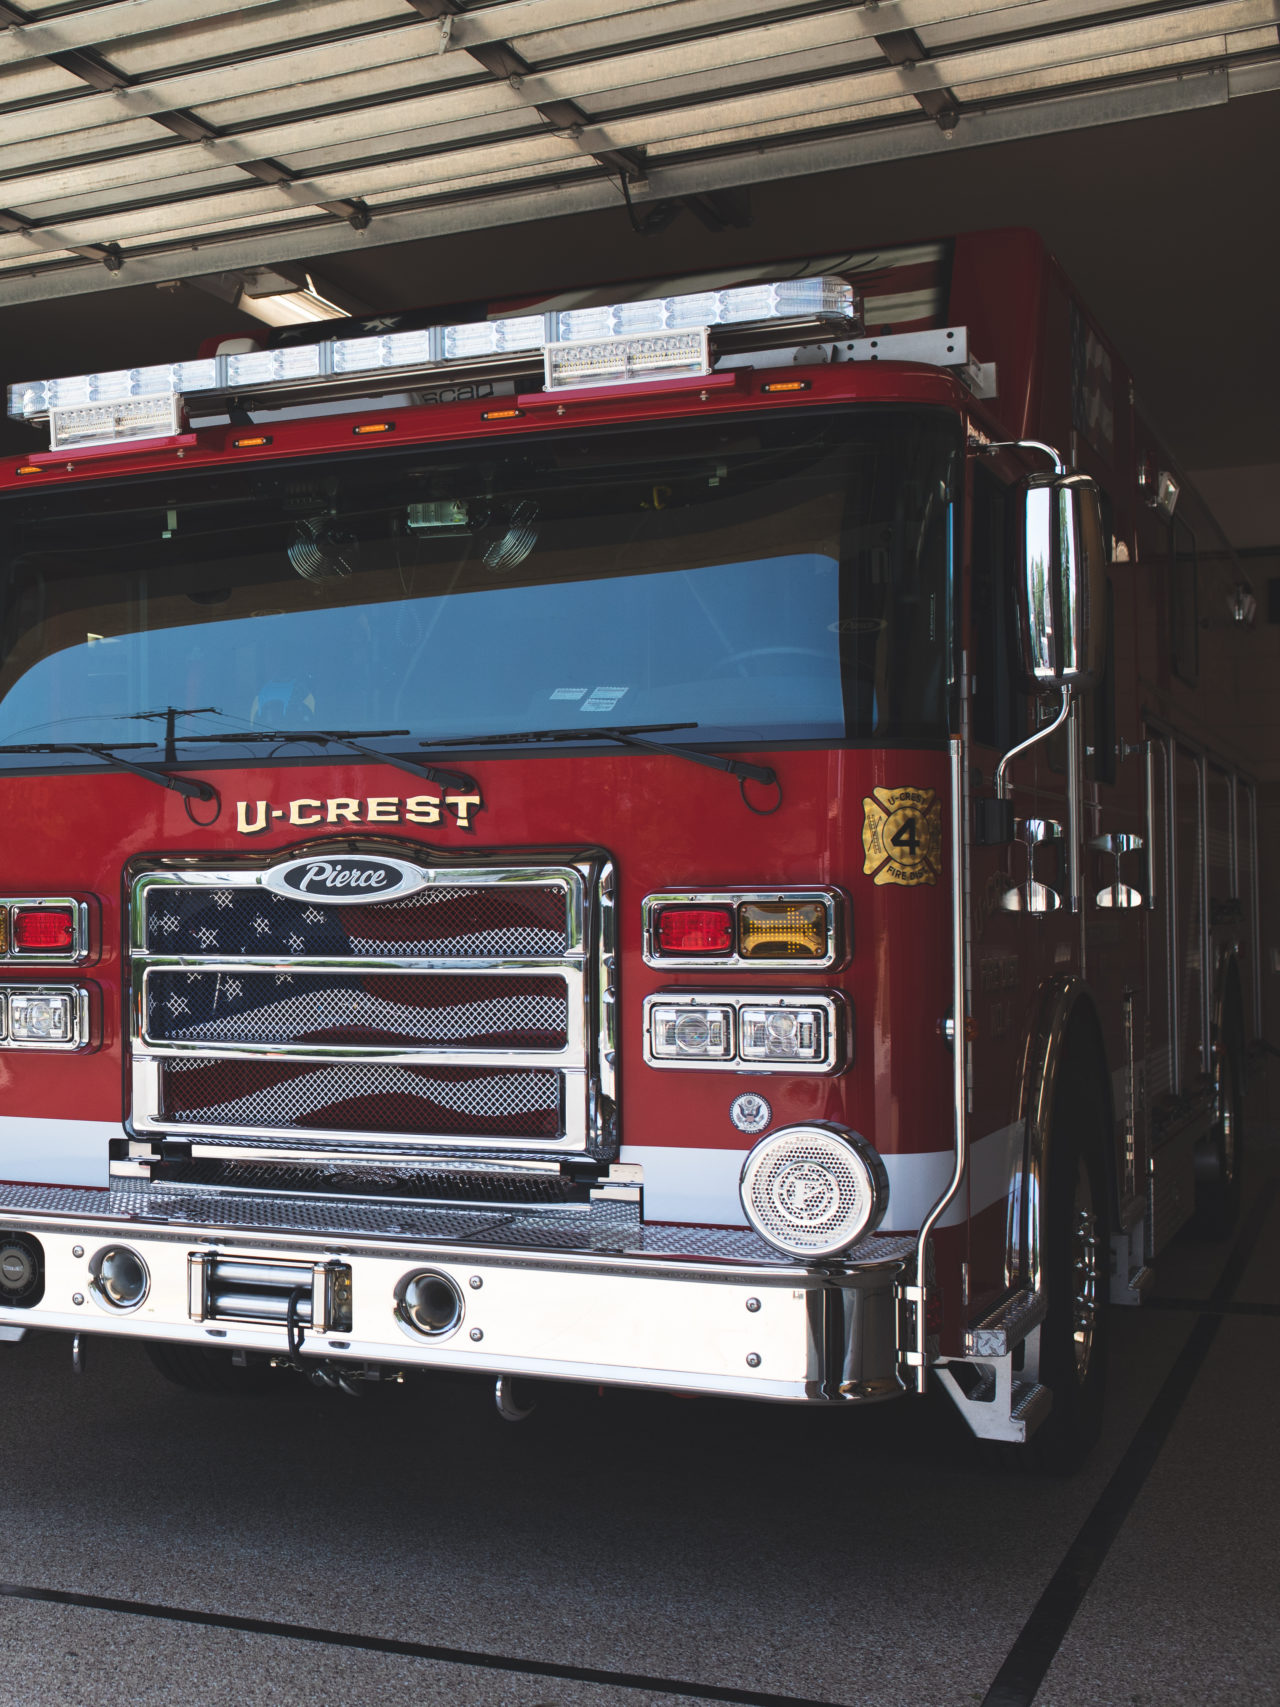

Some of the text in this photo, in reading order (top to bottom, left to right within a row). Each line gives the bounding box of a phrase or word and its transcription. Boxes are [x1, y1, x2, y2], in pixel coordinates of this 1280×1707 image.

[236, 795, 481, 834] U-CREST
[887, 792, 928, 806] U-CREST
[890, 817, 921, 856] 4
[298, 861, 388, 892] Pierce
[886, 865, 907, 881] FIRE
